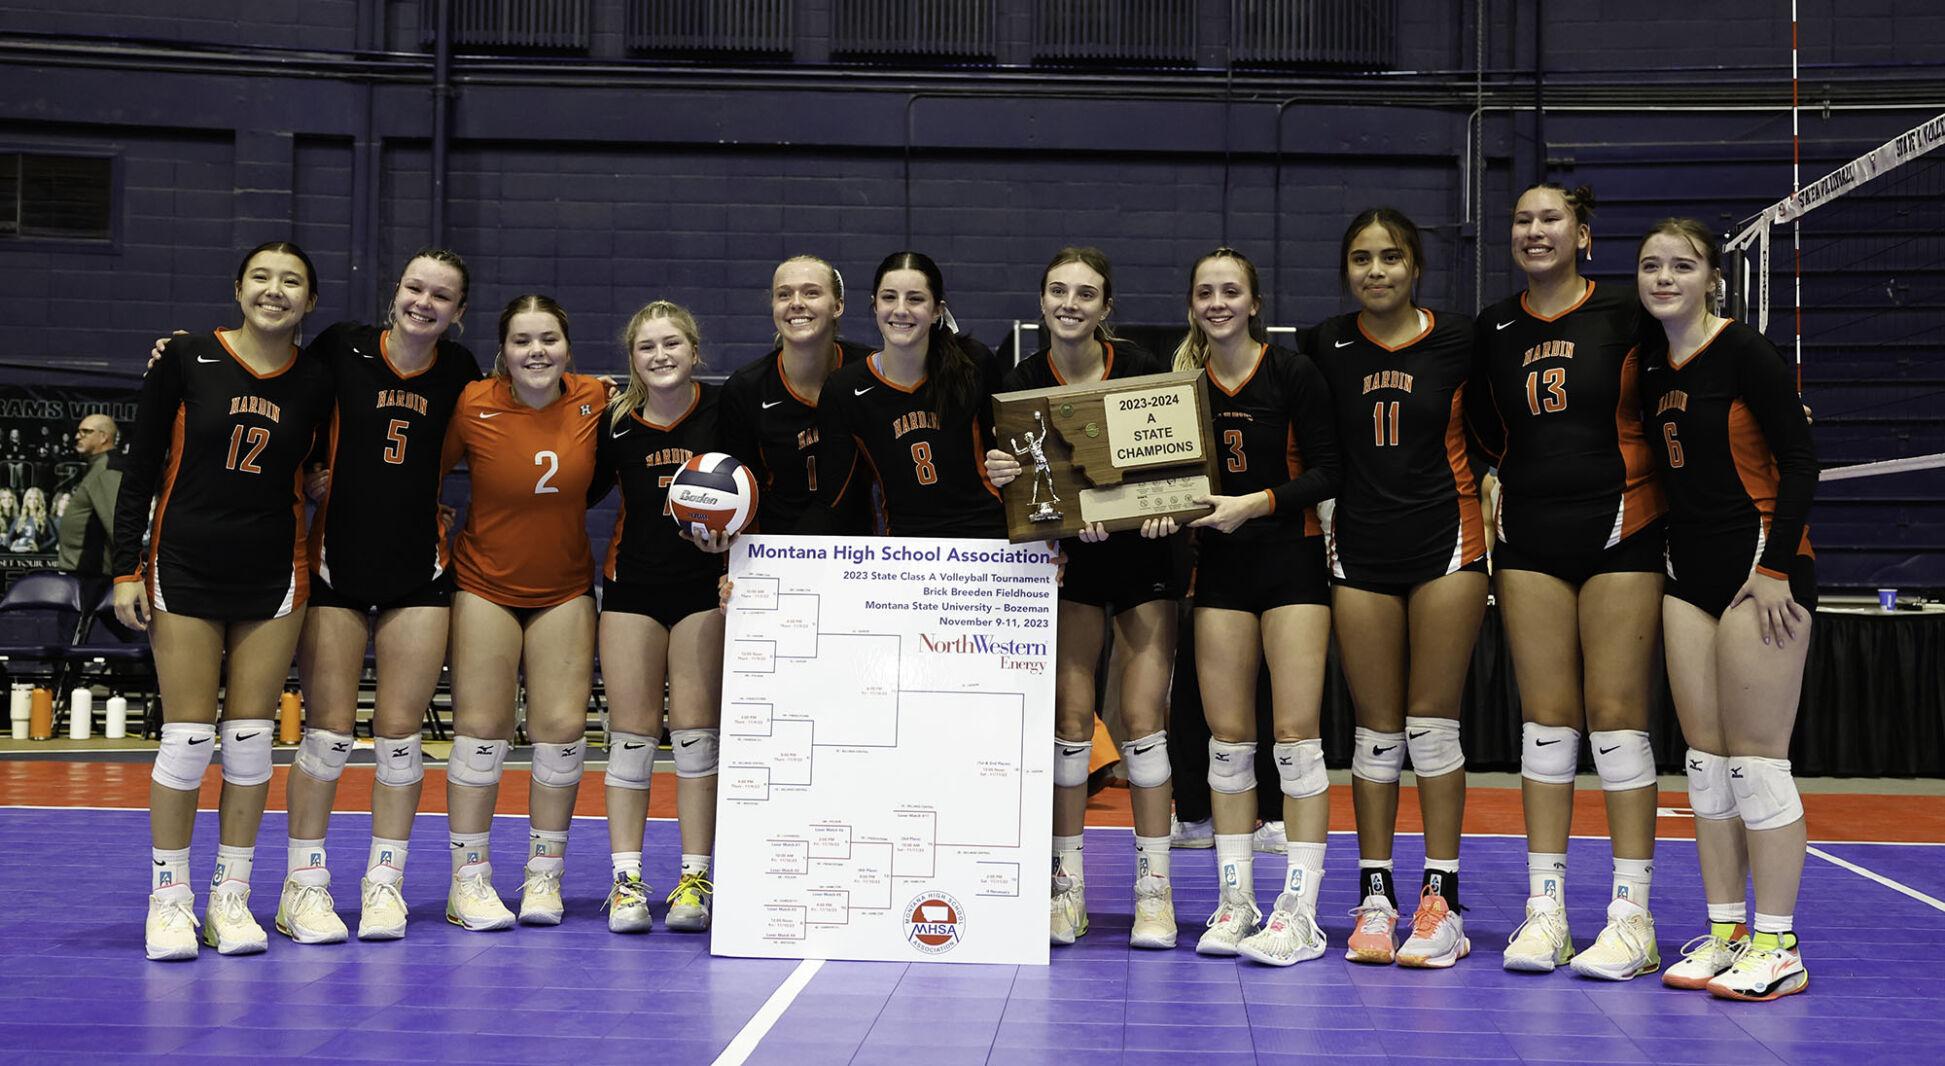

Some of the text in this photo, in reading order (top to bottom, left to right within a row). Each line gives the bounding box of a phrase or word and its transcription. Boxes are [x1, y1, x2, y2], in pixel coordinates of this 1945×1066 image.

[1522, 340, 1575, 367] HARDIN
[1362, 370, 1414, 395] HARDIN
[1525, 367, 1567, 415] 13
[229, 396, 280, 423] HARDIN
[376, 390, 428, 416] HARDIN
[1119, 394, 1180, 411] 2023-2024
[1656, 389, 1688, 416] HARDIN
[1147, 413, 1157, 424] A
[1373, 401, 1400, 446] 11
[383, 418, 410, 465] 5
[1134, 427, 1173, 441] STATE
[1663, 422, 1685, 468] 6
[226, 424, 271, 474] 12
[645, 447, 694, 468] HARDIN
[1117, 441, 1194, 460] CHAMPIONS
[1224, 429, 1248, 473] 3
[534, 450, 560, 494] 2
[806, 455, 817, 491] 1
[911, 441, 938, 486] 8
[748, 543, 1050, 564] Montana High School Association
[844, 571, 868, 579] 2023
[871, 572, 897, 580] State
[901, 572, 925, 581] Class
[940, 573, 988, 584] Volleyball
[991, 574, 1050, 584] Tournament
[924, 587, 1049, 598] Brick Breeden Fieldhouse
[866, 601, 909, 609] Montana
[912, 602, 938, 610] State
[942, 603, 992, 613] University
[1004, 604, 1049, 613] Bozeman
[940, 617, 1048, 628] November 9-11, 2023
[919, 634, 1048, 657] NorthWestern
[1001, 657, 1046, 675] Energy
[905, 895, 926, 924] MONTANA
[948, 898, 964, 926] SCHOOL
[909, 924, 959, 941] MHSA
[912, 940, 955, 953] ASSOCIATION
